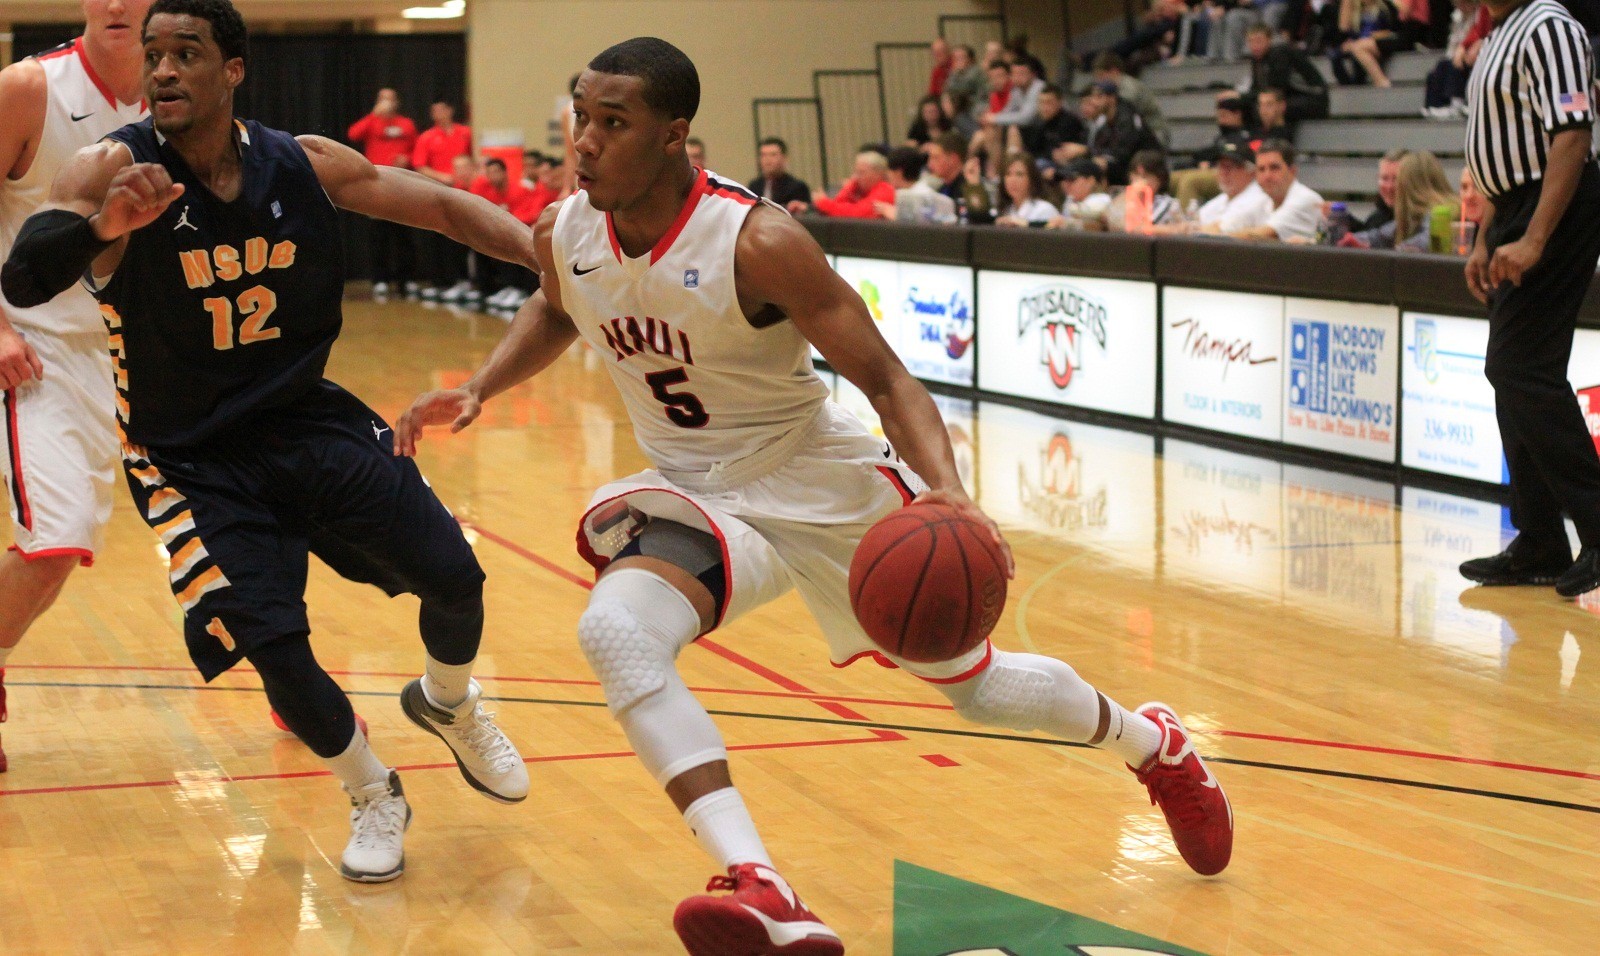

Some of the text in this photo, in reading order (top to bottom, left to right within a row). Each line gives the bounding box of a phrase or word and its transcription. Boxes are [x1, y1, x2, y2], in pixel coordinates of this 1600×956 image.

[179, 236, 297, 290] MSUB
[203, 285, 281, 350] 12
[1018, 290, 1107, 350] CRUSADERS
[1332, 324, 1386, 350] NOBODY
[1331, 371, 1355, 395] LIKE
[1332, 349, 1377, 375] KNOWS
[645, 366, 710, 428] 5
[1331, 394, 1393, 427] DOMINO'S
